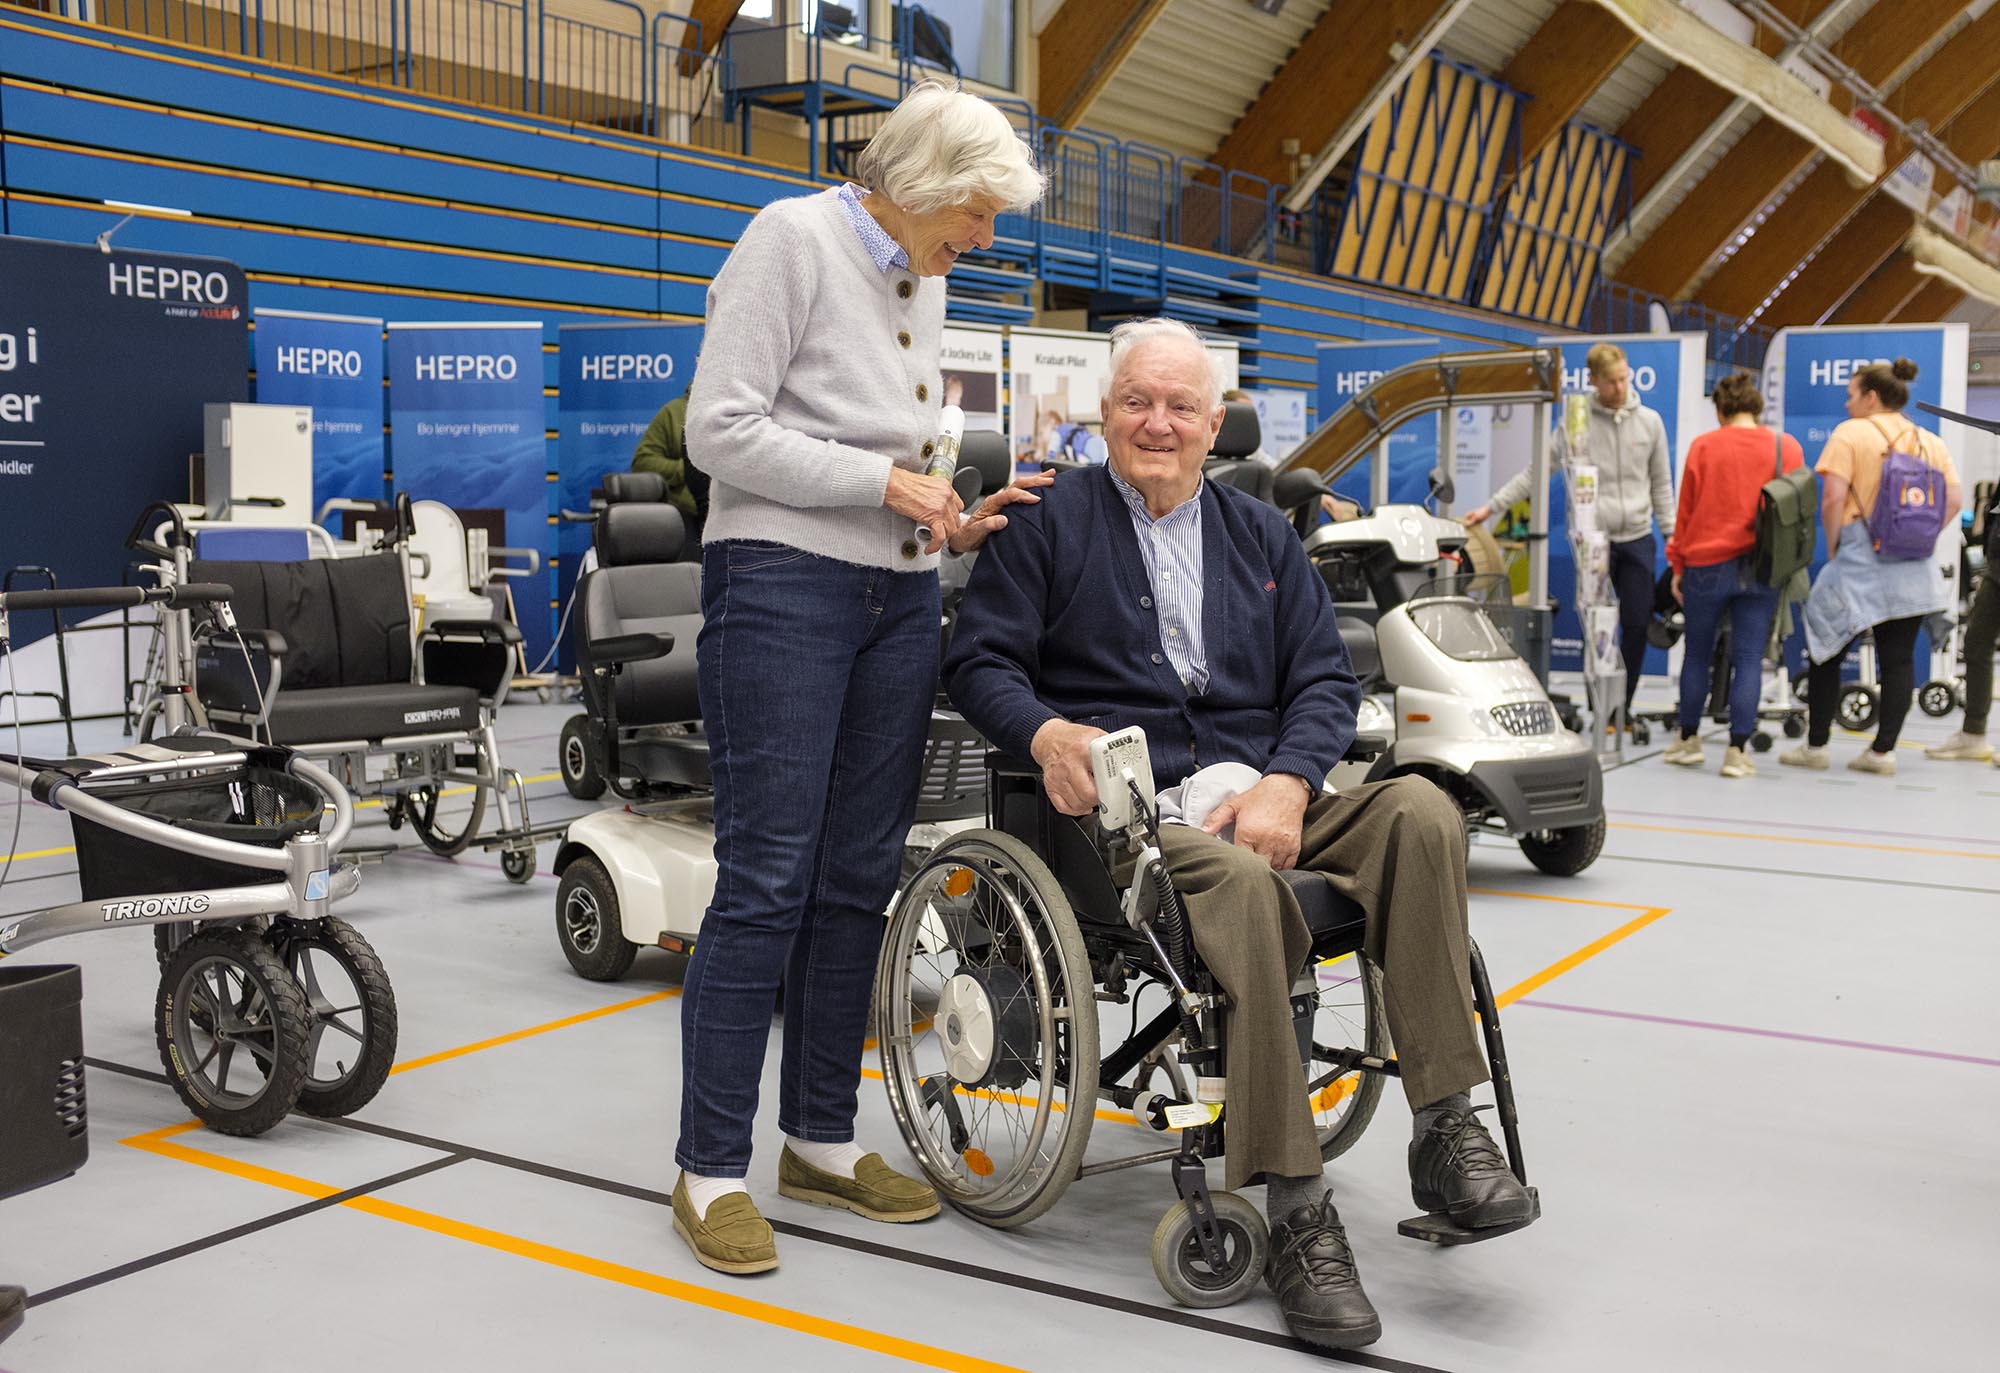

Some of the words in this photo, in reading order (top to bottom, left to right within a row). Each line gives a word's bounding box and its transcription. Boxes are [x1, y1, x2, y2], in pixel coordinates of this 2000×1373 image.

[109, 262, 228, 304] HEPRO
[27, 327, 37, 364] i
[277, 345, 361, 377] HEPRO
[416, 354, 517, 380] HEPRO
[582, 353, 673, 381] HEPRO
[1035, 353, 1064, 366] Krabat
[1561, 365, 1656, 392] HEO
[0, 393, 41, 423] er
[325, 419, 363, 435] hjemme
[417, 422, 433, 436] Bo
[472, 421, 520, 437] hjemme
[581, 422, 596, 435] Bo
